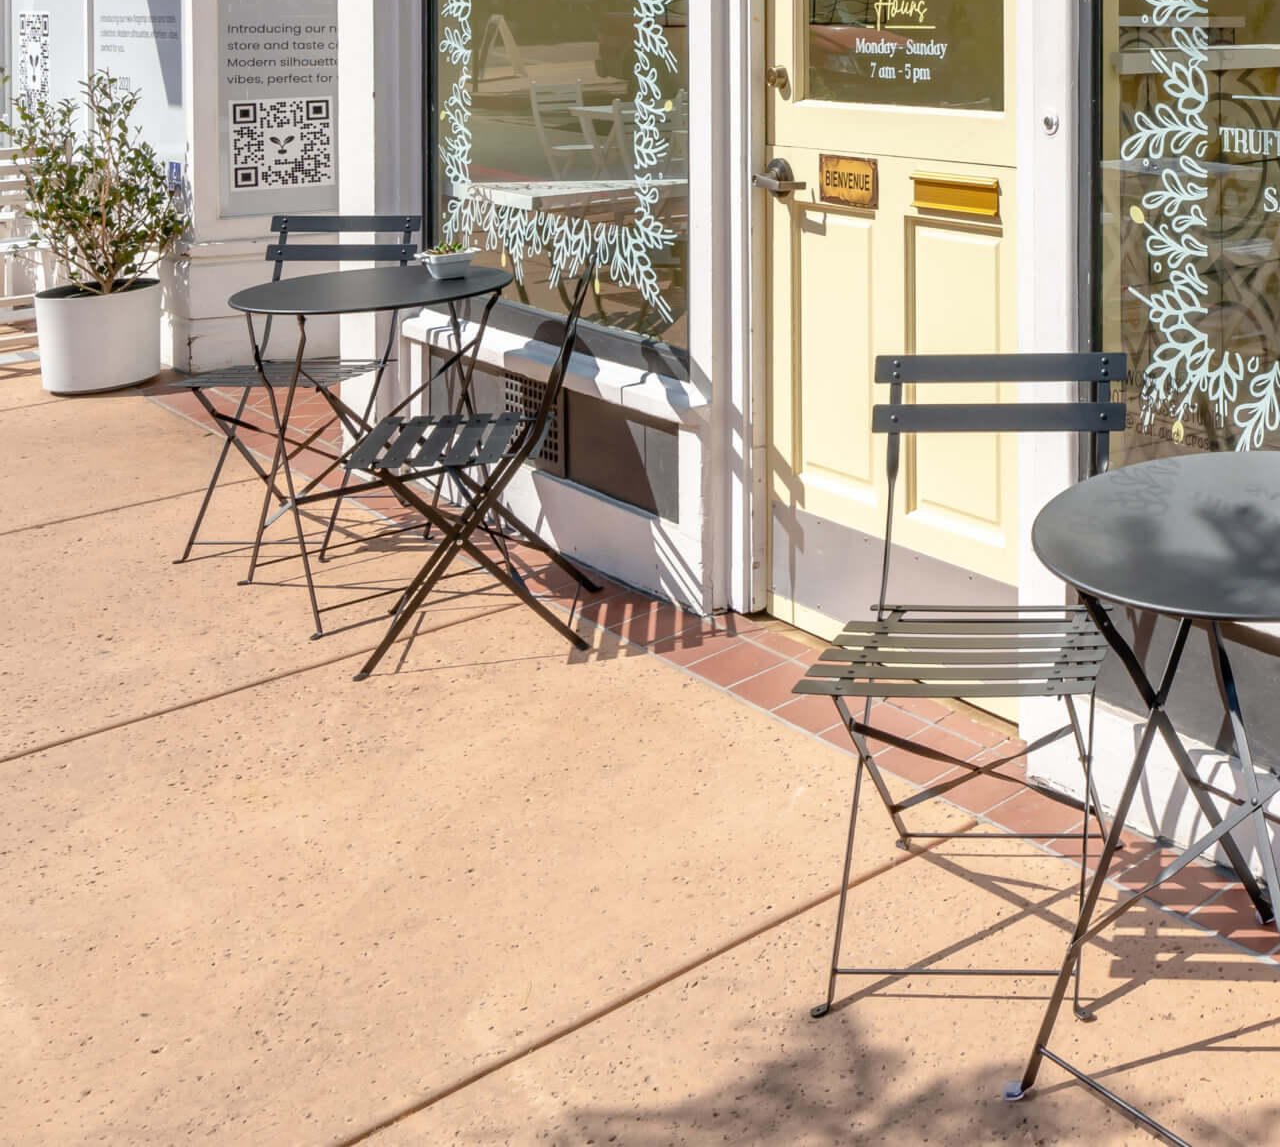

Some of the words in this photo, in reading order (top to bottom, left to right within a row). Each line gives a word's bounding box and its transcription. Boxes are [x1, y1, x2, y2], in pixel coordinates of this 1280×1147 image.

[227, 24, 301, 36] Introducing
[227, 41, 260, 50] store
[264, 41, 288, 50] and
[293, 41, 324, 50] taste
[855, 37, 897, 58] Monday
[905, 39, 948, 60] Sunday
[227, 57, 276, 67] Modern
[870, 62, 877, 79] 7
[878, 66, 896, 80] am
[904, 63, 911, 80] 5
[912, 66, 931, 84] pm
[226, 74, 264, 84] vibes,
[267, 74, 312, 86] perfect
[316, 74, 332, 83] for
[825, 170, 870, 192] BIENVENUE
